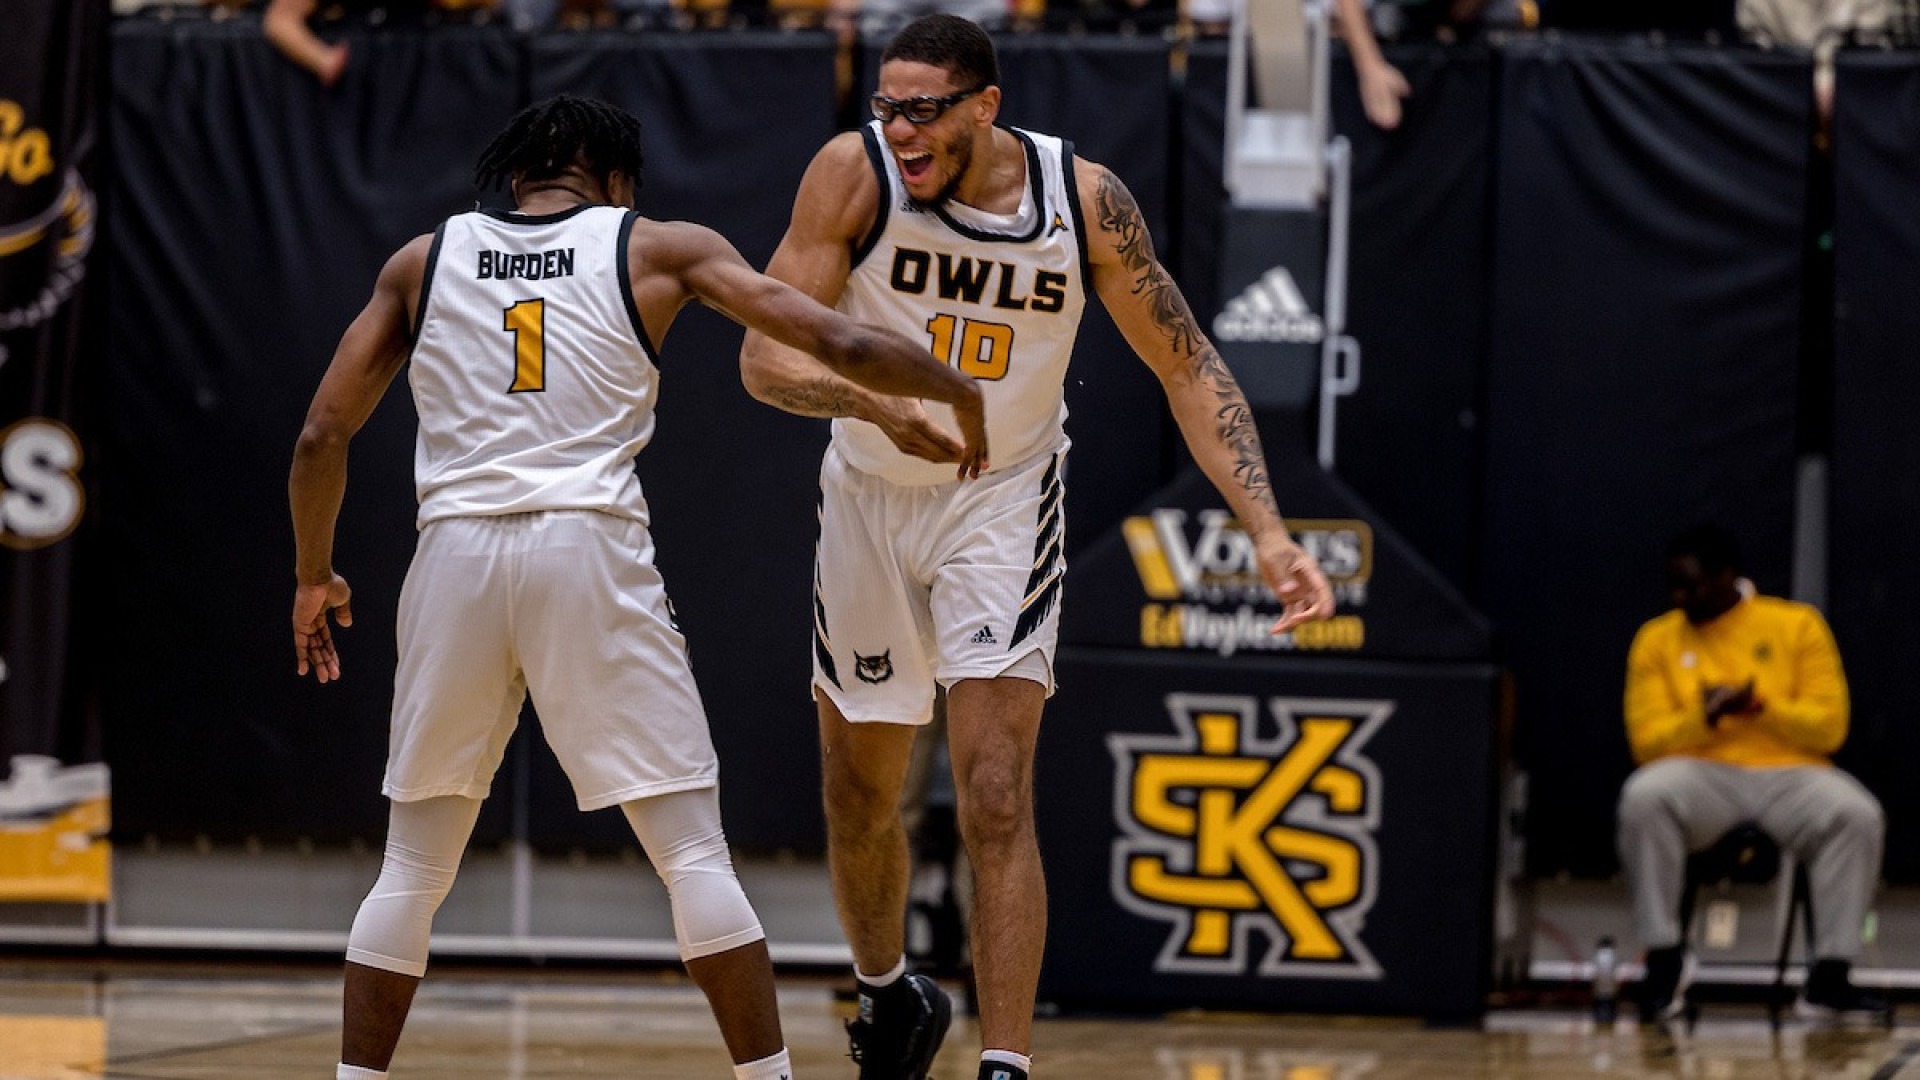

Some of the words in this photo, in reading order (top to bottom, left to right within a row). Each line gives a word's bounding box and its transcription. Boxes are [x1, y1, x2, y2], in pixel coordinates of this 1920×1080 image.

[477, 248, 575, 280] BURDEN
[890, 246, 1067, 313] OWLS
[503, 297, 546, 394] 1
[927, 312, 1015, 381] 10
[970, 636, 998, 644] adidas
